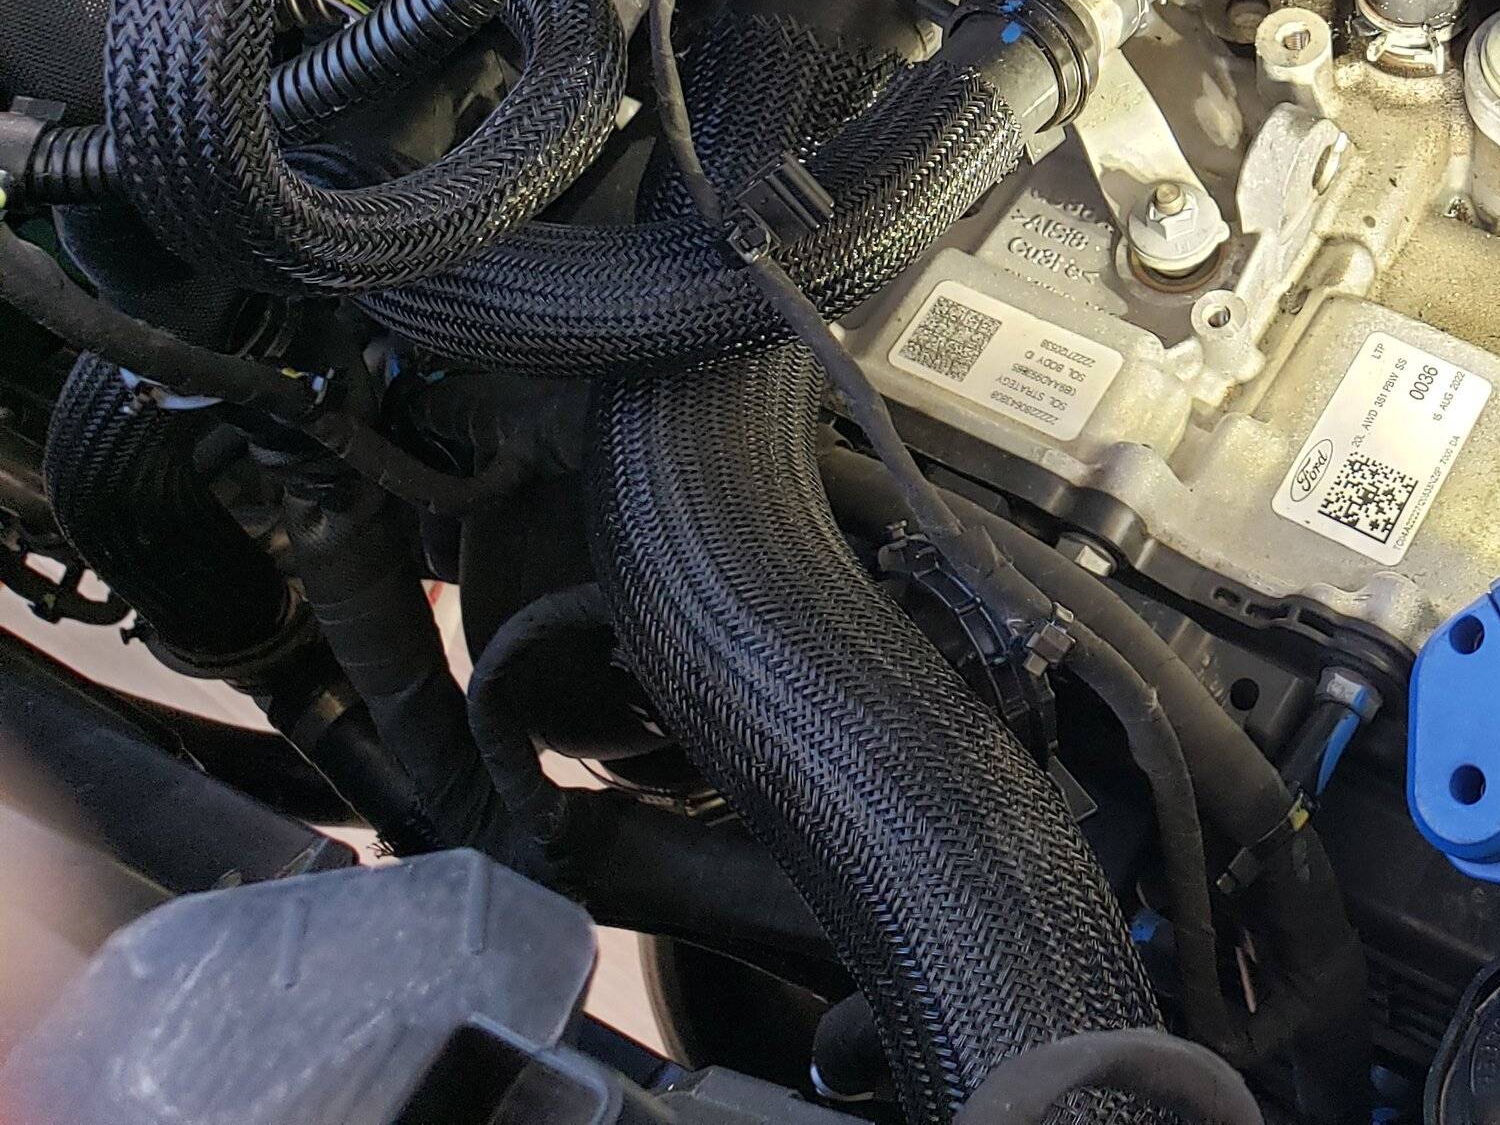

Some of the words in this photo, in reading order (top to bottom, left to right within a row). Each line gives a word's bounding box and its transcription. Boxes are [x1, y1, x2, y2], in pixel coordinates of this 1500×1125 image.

[1036, 356, 1064, 372] BODY
[1371, 342, 1387, 360] LTP
[995, 374, 1045, 401] STRATEGY
[1361, 408, 1378, 430] AWD
[1382, 371, 1399, 392] PBW
[1394, 357, 1407, 371] SS
[1407, 363, 1439, 402] 0036
[1432, 412, 1442, 422] 15
[1438, 391, 1454, 410] AUG
[1448, 369, 1465, 390] 2022
[1297, 449, 1328, 492] Ford
